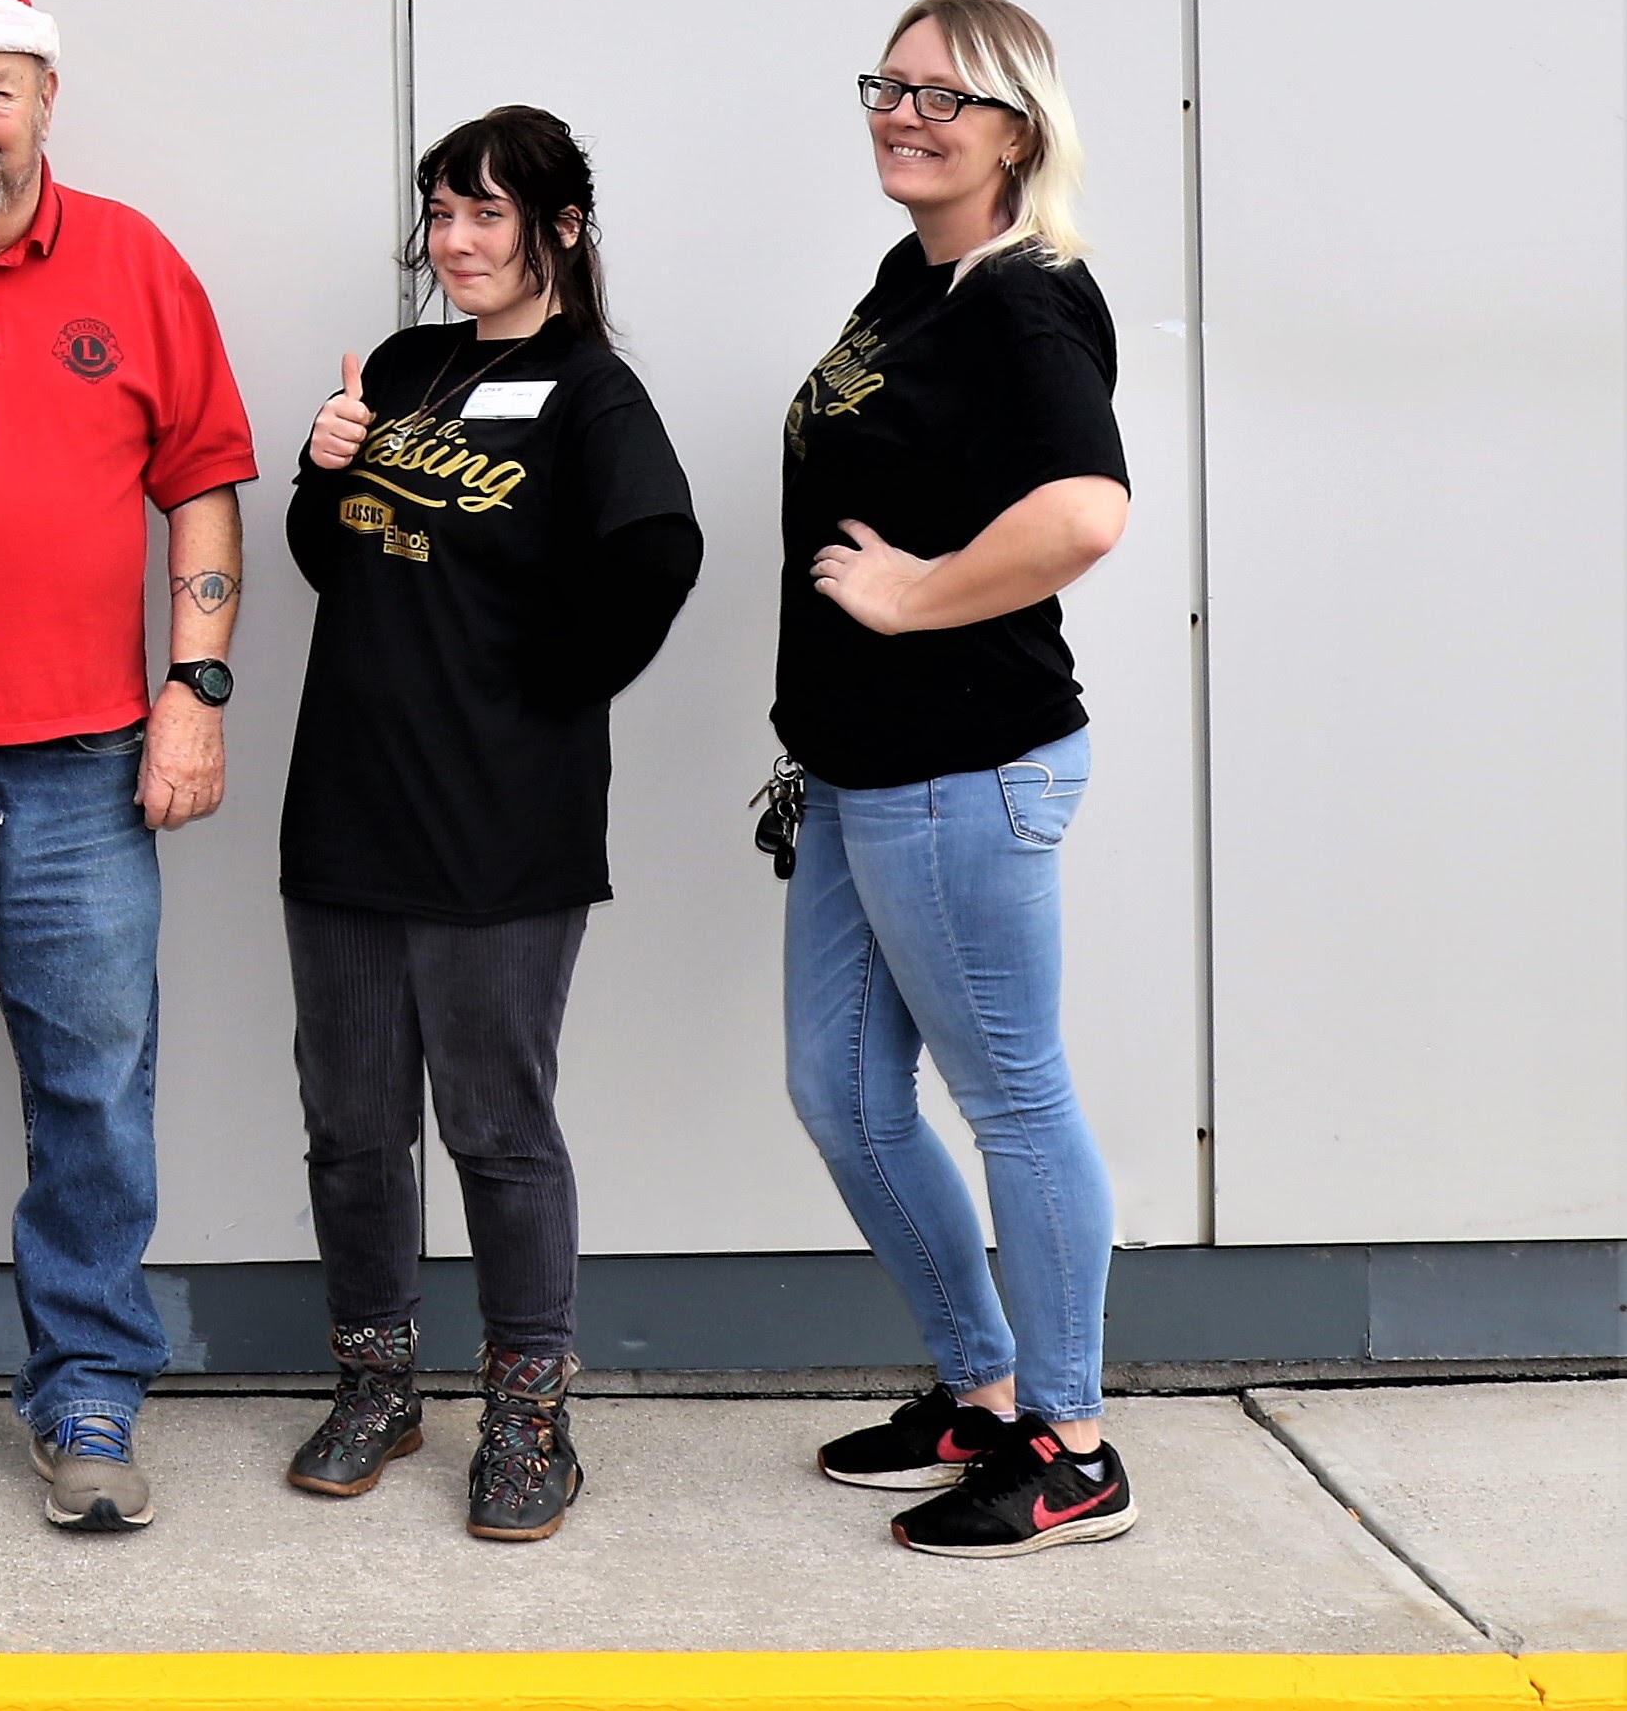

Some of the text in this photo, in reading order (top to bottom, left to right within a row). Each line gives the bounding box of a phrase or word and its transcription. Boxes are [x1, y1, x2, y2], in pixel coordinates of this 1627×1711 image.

[82, 338, 100, 360] L
[363, 411, 526, 513] lessing
[345, 502, 385, 526] LASSUS
[384, 525, 430, 551] Elmo's
